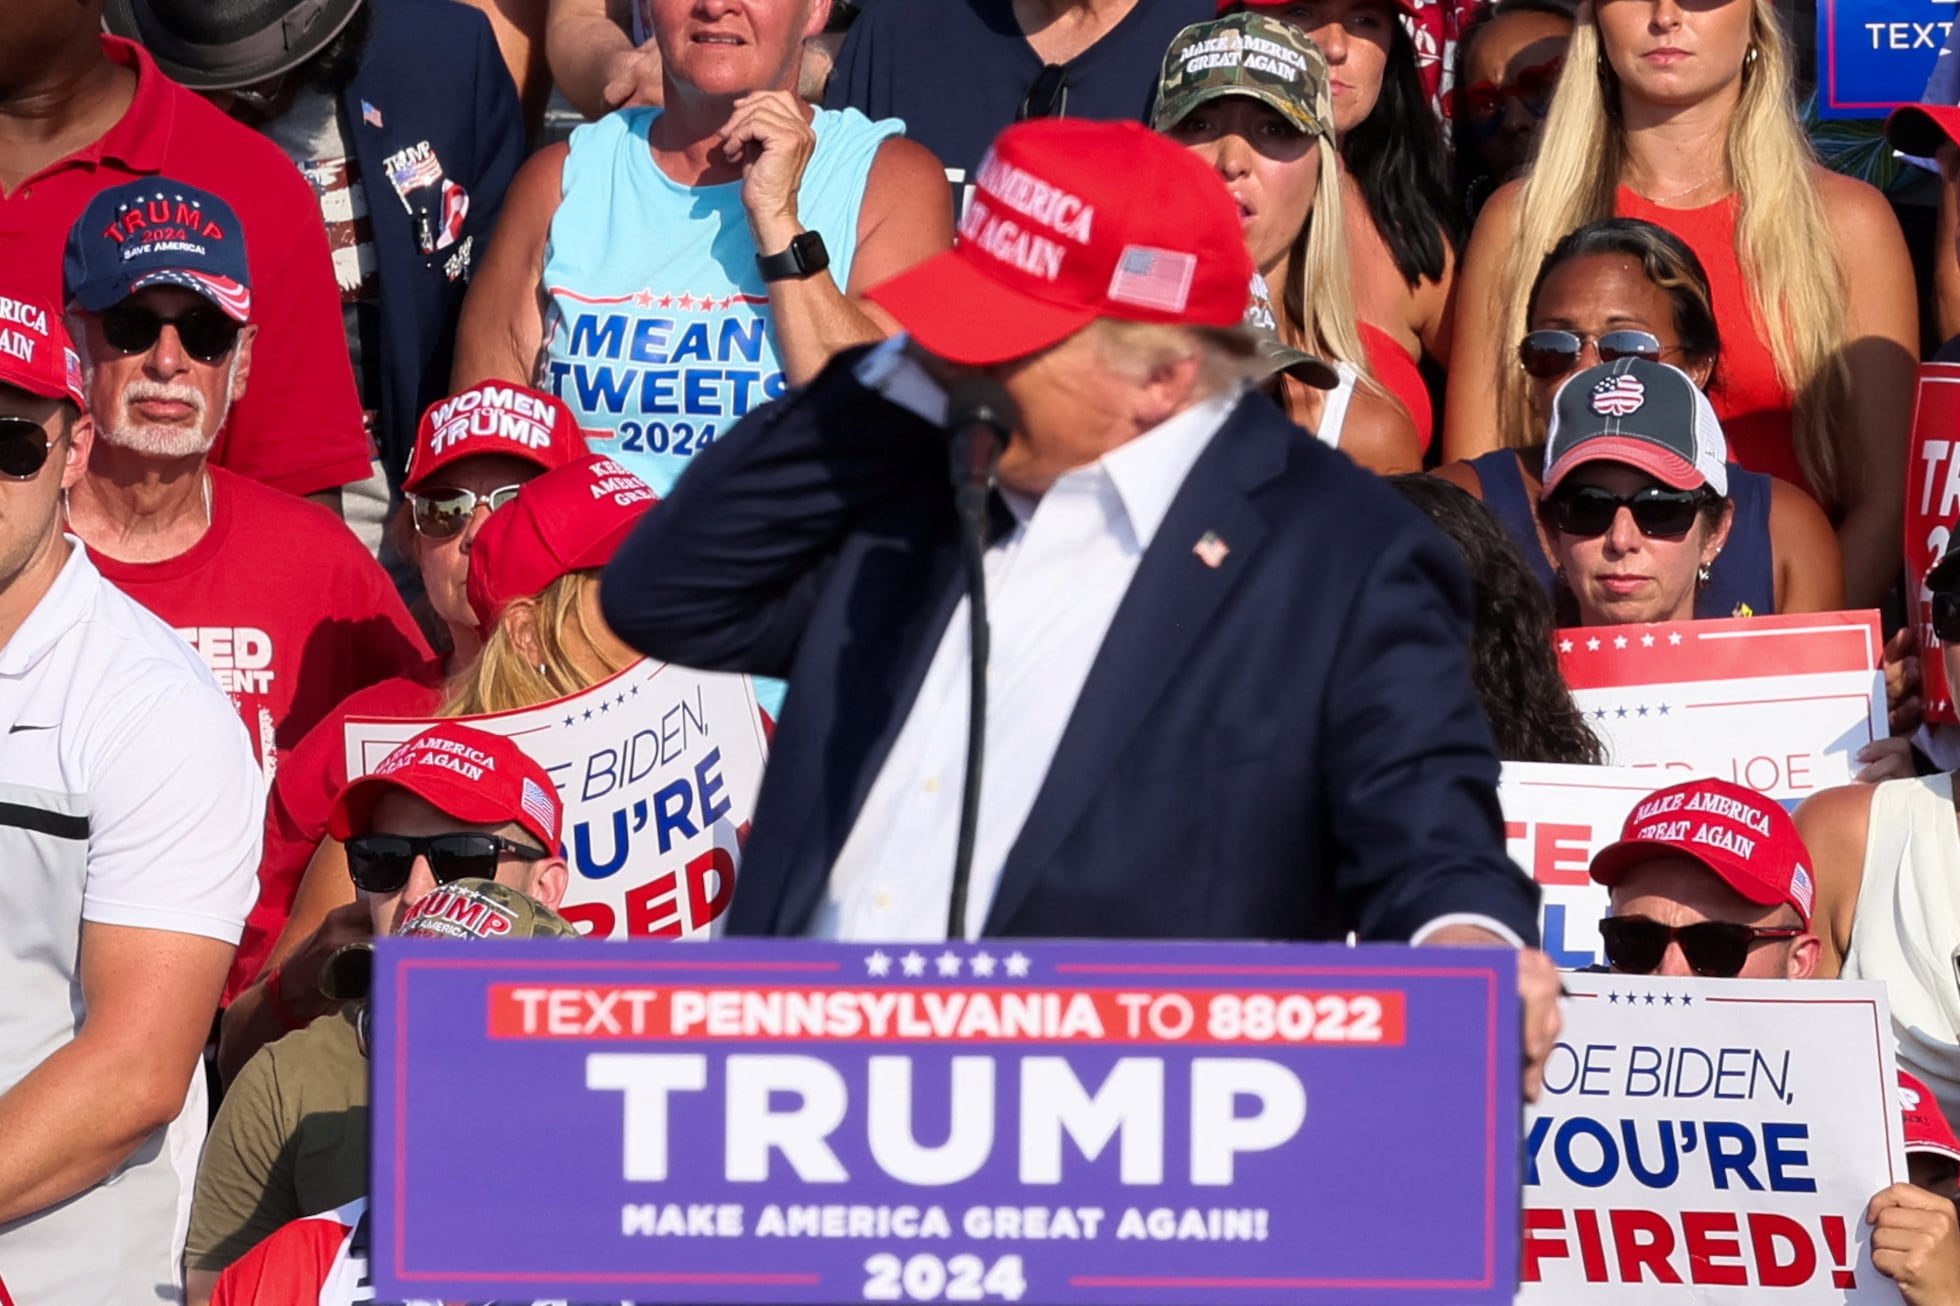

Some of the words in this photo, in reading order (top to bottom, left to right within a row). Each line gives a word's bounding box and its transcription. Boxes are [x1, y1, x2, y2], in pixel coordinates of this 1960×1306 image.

[1179, 36, 1229, 62] MAKE
[1231, 33, 1307, 71] AMERICA
[1864, 22, 1954, 50] TEXT
[1186, 51, 1241, 73] GREAT
[1243, 53, 1297, 82] AGAIN
[102, 199, 225, 243] TRUMP
[141, 227, 187, 243] 2024
[123, 244, 151, 264] SAVE
[976, 214, 1066, 281] AGAIN
[568, 312, 766, 364] MEAN
[430, 386, 557, 430] WOMEN
[473, 406, 505, 416] FOR
[430, 414, 552, 456] TRUMP
[619, 421, 716, 456] 2024
[588, 460, 633, 478] KEE
[411, 737, 496, 771] AMERICA
[581, 684, 709, 803] BIDEN,
[418, 751, 484, 781] AGAIN
[561, 745, 732, 880] U'RE
[1634, 792, 1685, 824] MAKE
[1684, 792, 1771, 837] AMERICA
[1637, 821, 1690, 843] GREAT
[1692, 823, 1755, 861] AGAIN
[511, 988, 657, 1035] TEXT
[670, 991, 1105, 1038] PENNSYLVANIA
[1115, 992, 1195, 1040] TO
[1207, 994, 1383, 1041] 88022
[1625, 1045, 1793, 1106] BIDEN,
[585, 1053, 1307, 1187] TRUMP
[621, 1204, 744, 1237] MAKE
[755, 1205, 951, 1239] AMERICA
[963, 1206, 1105, 1240] GREAT
[1116, 1208, 1269, 1242] AGAIN!
[1520, 1208, 1857, 1290] FIRED!
[862, 1253, 1027, 1301] 2024
